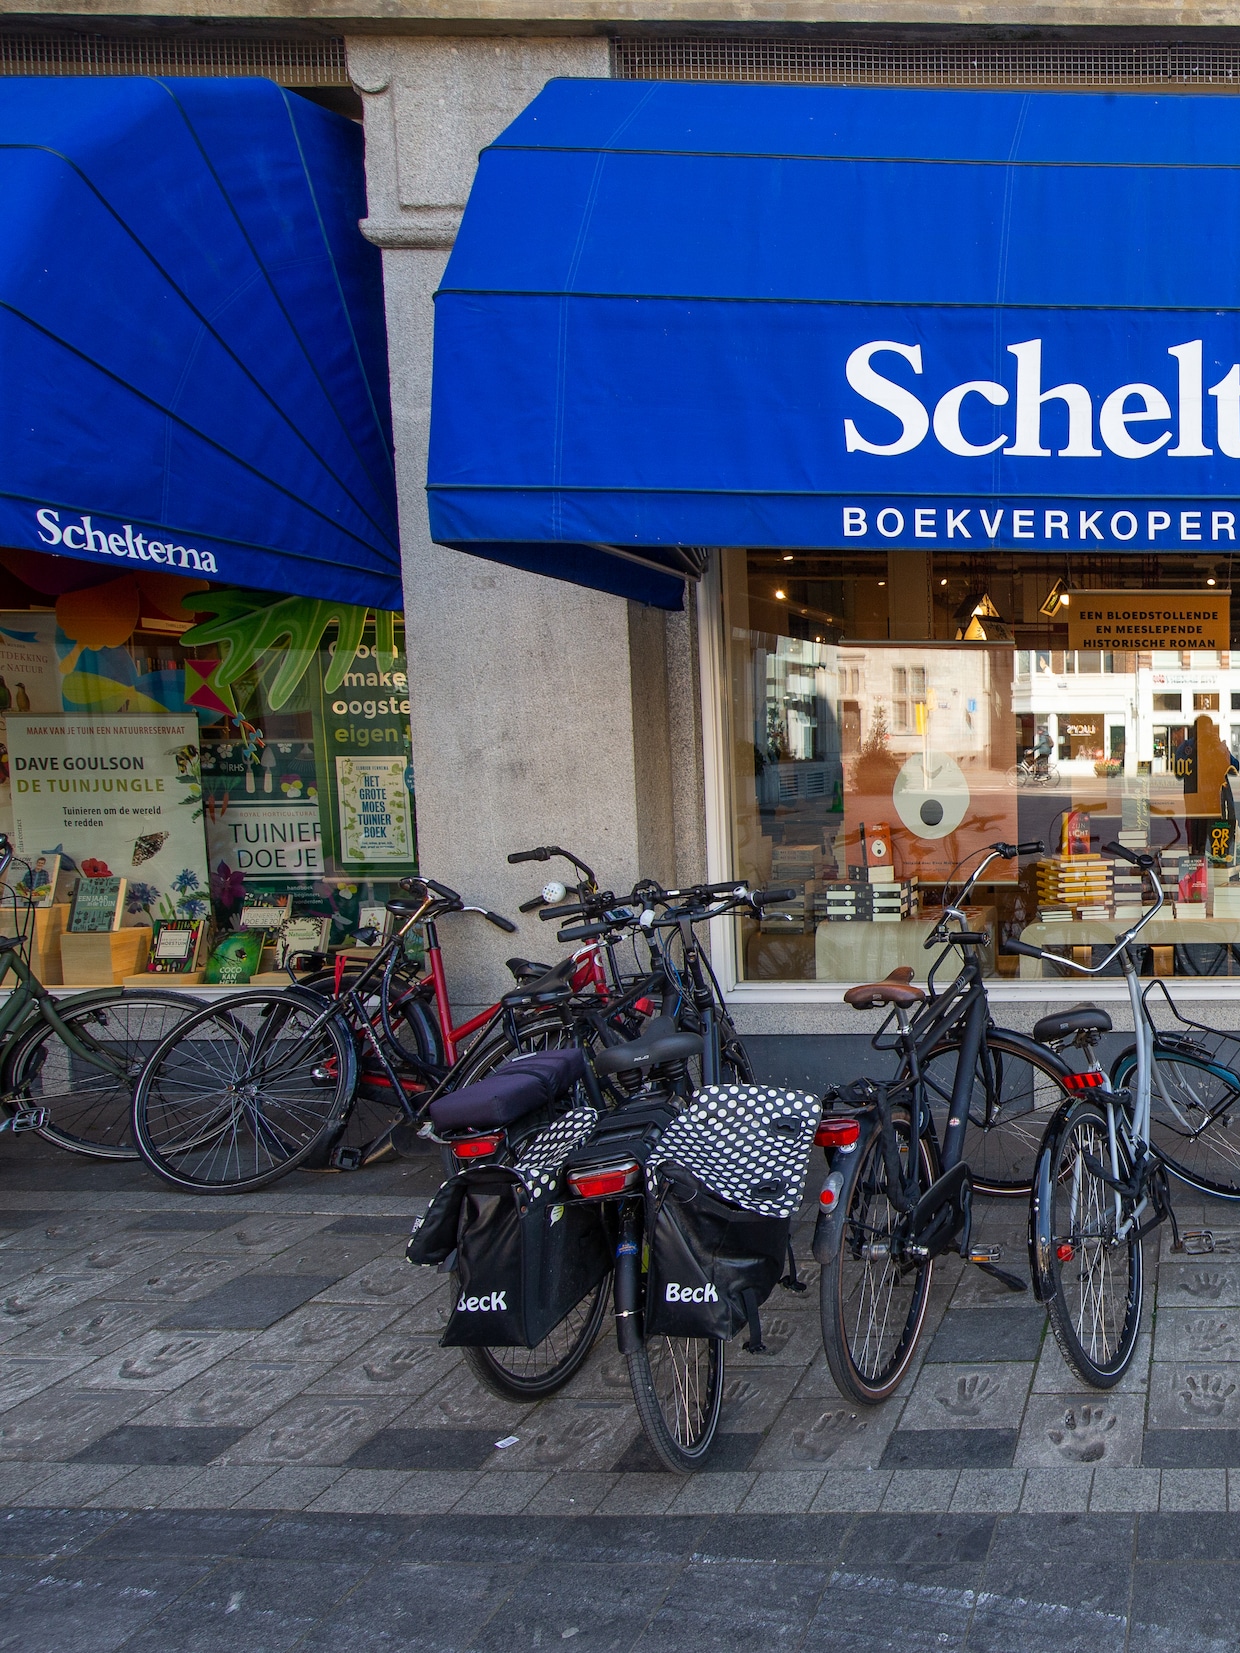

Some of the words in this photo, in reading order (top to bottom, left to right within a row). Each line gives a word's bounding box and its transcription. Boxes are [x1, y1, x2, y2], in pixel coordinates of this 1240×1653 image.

[36, 508, 218, 573] Scheltema
[1080, 612, 1102, 620] EEN
[1107, 612, 1218, 620] BLOEDSTOLLENDE
[1096, 626, 1111, 634] EN
[1116, 626, 1203, 634] MEESLEPENDE
[1083, 639, 1165, 648] HISTORISCHE
[1170, 639, 1215, 648] ROMAN
[7, 664, 43, 673] NATUUR
[332, 697, 410, 719] oogste
[26, 727, 48, 735] MAAK
[50, 727, 65, 735] VAN
[66, 727, 75, 735] JE
[113, 726, 185, 734] NATUURRESERVAAT
[335, 724, 398, 747] eigen
[15, 757, 59, 770] DAVE
[63, 757, 144, 770] GOULSON
[229, 763, 244, 772] RHS
[17, 779, 41, 793] DE
[47, 779, 165, 792] TUINJUNGLE
[364, 776, 379, 787] HET
[359, 789, 387, 800] GROTE
[63, 806, 101, 815] Tuinieren
[119, 806, 129, 815] de
[132, 806, 161, 815] wereld
[362, 801, 385, 813] MOES
[74, 819, 103, 827] redden
[357, 814, 391, 825] TUINIER
[364, 827, 387, 838] BOEK
[238, 849, 286, 868] DOE
[294, 849, 317, 867] JE
